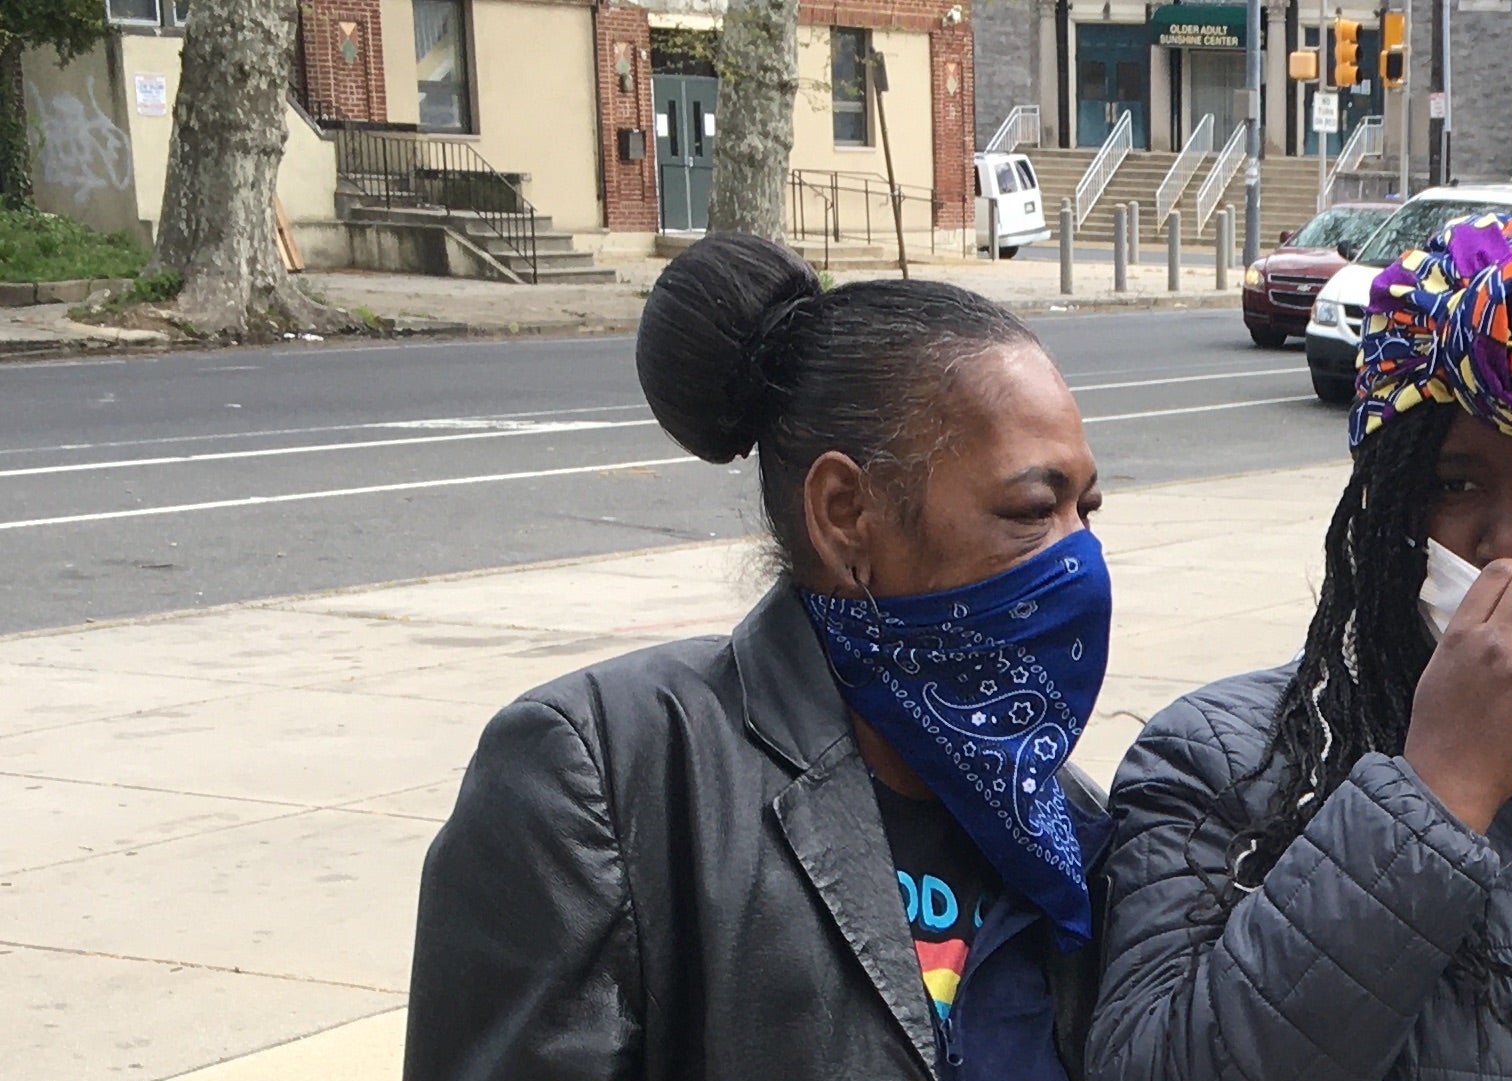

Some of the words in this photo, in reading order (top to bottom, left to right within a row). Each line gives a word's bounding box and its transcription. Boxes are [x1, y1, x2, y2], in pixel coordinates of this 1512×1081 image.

[1169, 23, 1199, 34] OLDER
[1200, 24, 1228, 35] ADULT
[1160, 34, 1201, 45] SUNSHINE
[1203, 35, 1239, 47] CENTER
